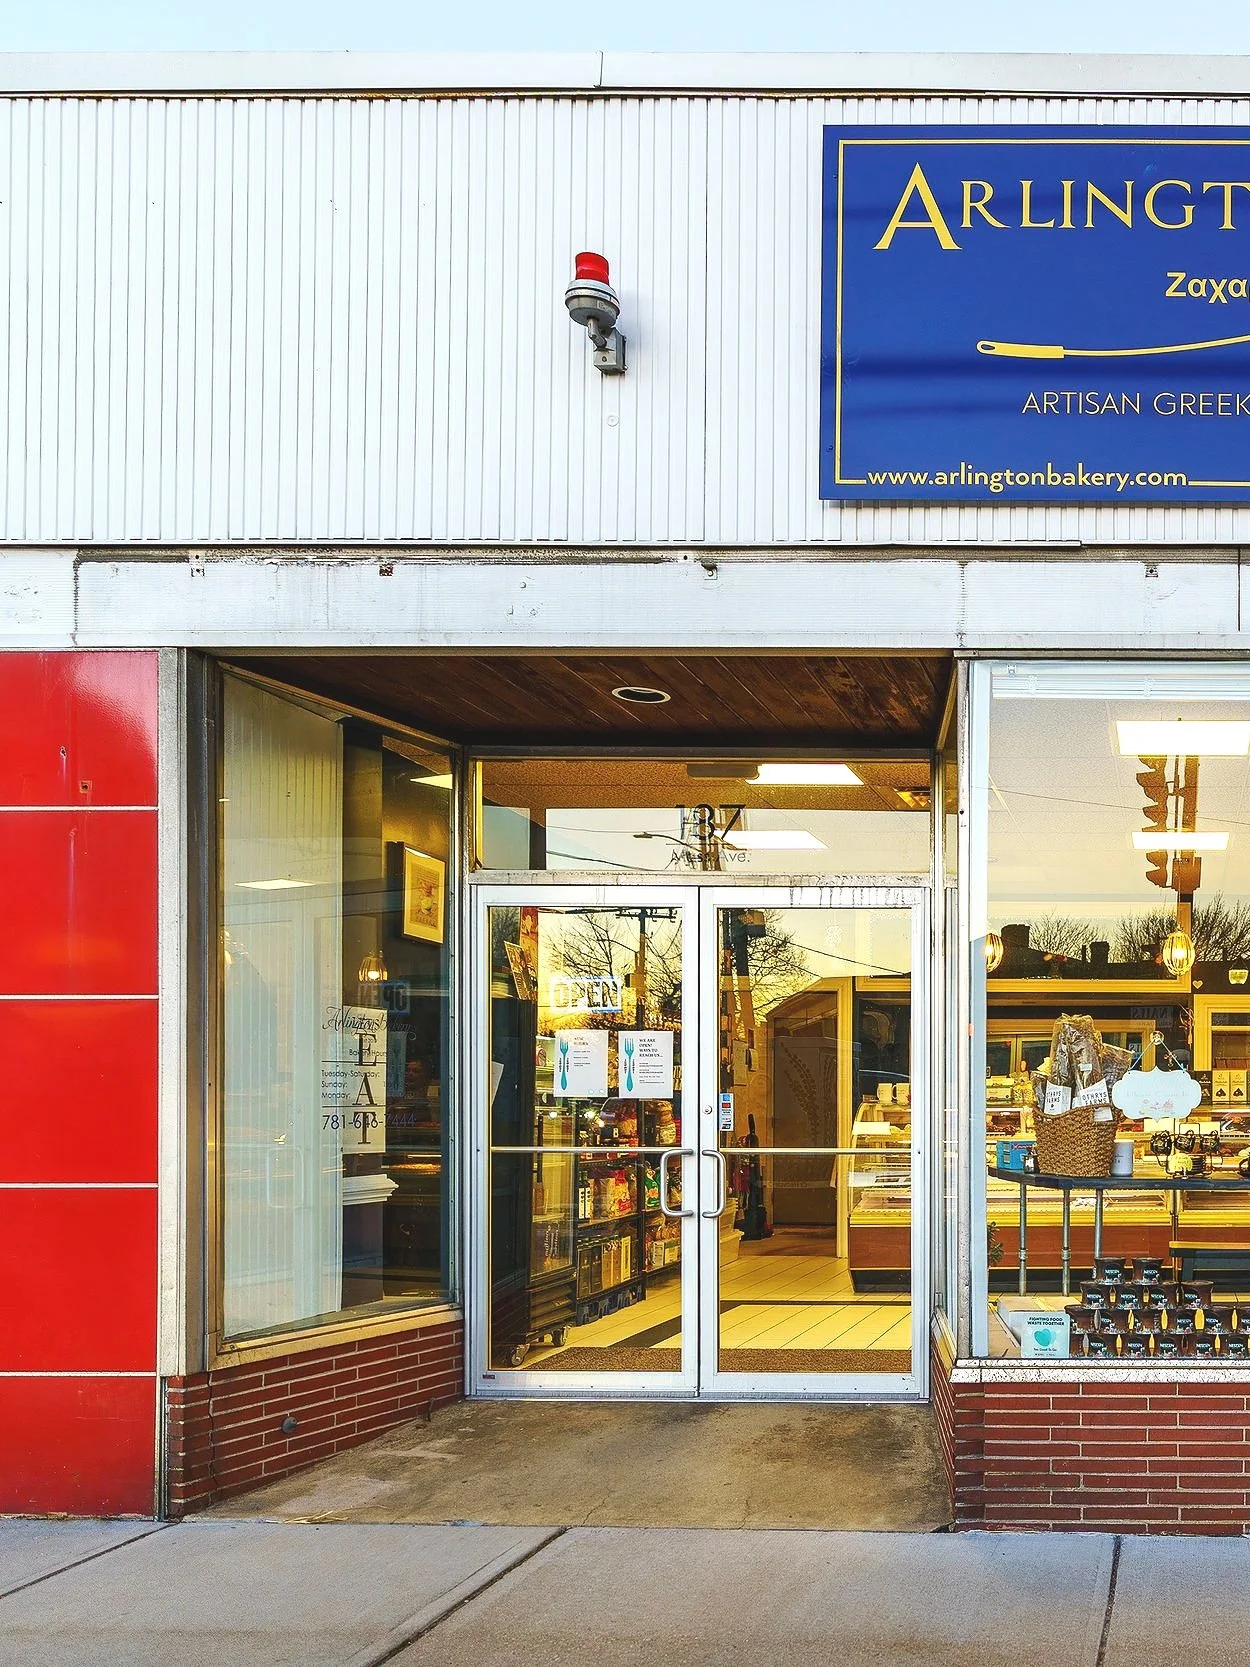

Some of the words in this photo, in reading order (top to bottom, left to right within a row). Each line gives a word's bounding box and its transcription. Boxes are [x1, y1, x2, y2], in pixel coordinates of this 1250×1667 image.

[1021, 392, 1141, 415] ARTISAN
[867, 465, 1188, 492] www.arlingtonbakery.com
[321, 1069, 380, 1079] Tuesday-Satuday:
